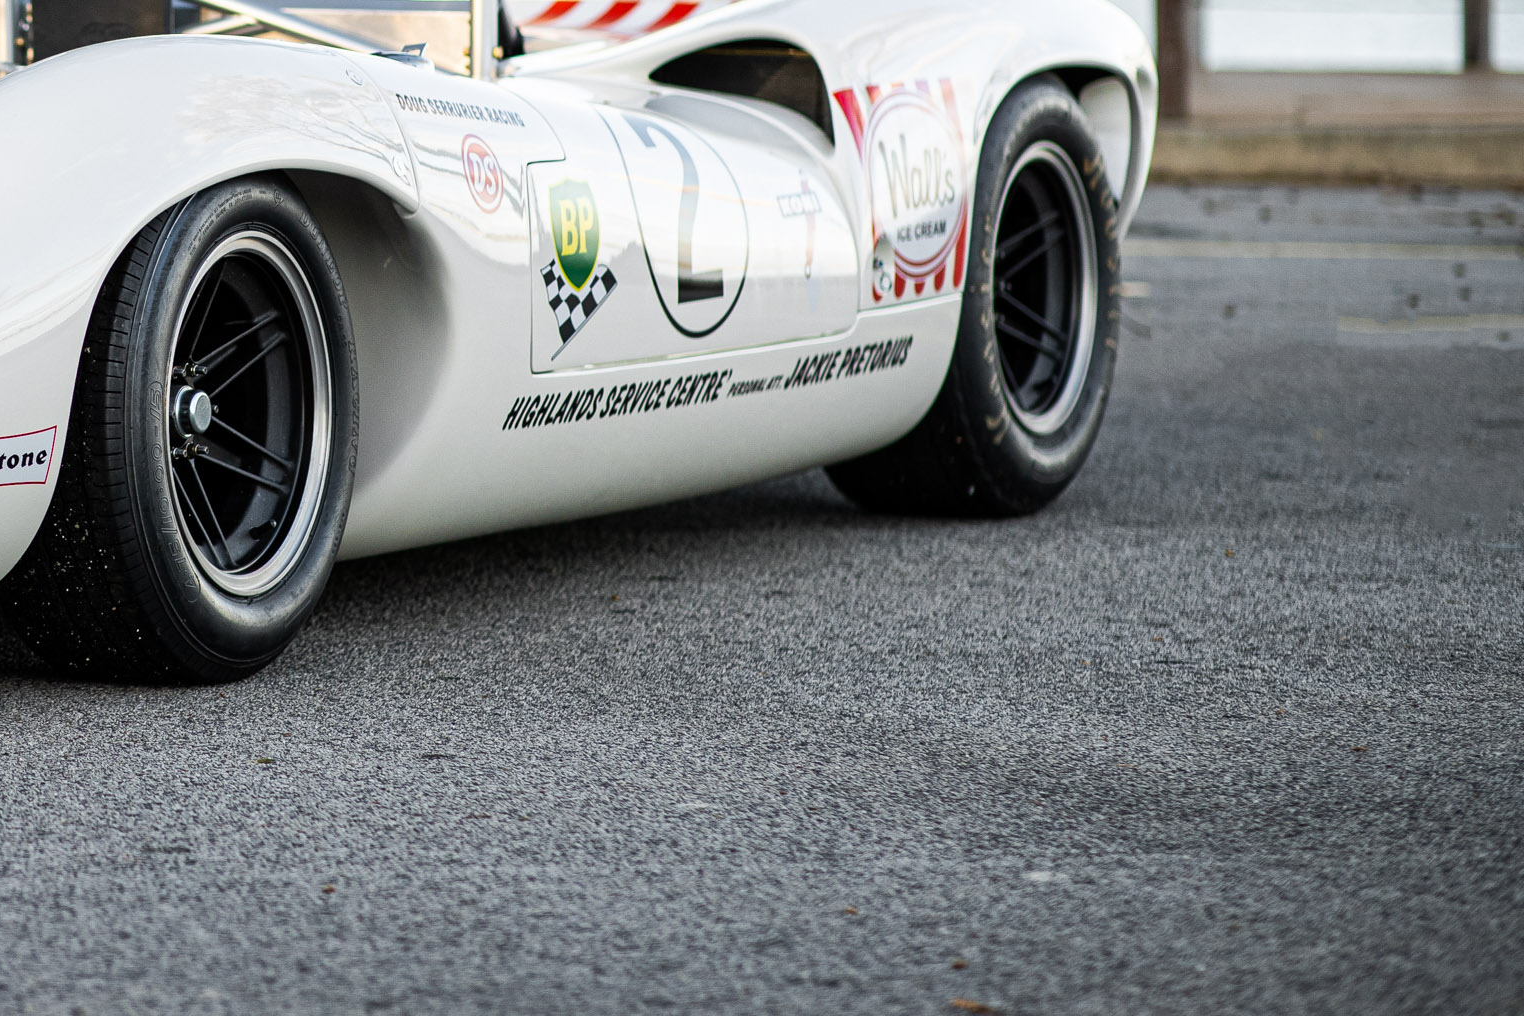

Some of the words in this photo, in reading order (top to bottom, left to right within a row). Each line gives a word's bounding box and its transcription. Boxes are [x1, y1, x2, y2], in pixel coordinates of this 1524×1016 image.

[395, 93, 429, 114] DOUG
[427, 97, 488, 122] SERRURIER
[484, 105, 526, 127] RACING
[622, 114, 724, 305] 2
[878, 132, 955, 219] Wall's
[559, 196, 594, 256] BP
[896, 226, 913, 243] ICE
[914, 219, 947, 240] CREAM
[502, 386, 604, 431] HIGHLANDS
[599, 377, 672, 420] SERVICE
[727, 377, 767, 398] PERSONAL
[784, 349, 843, 390] JACKIE
[836, 334, 914, 380] PRETORIUS
